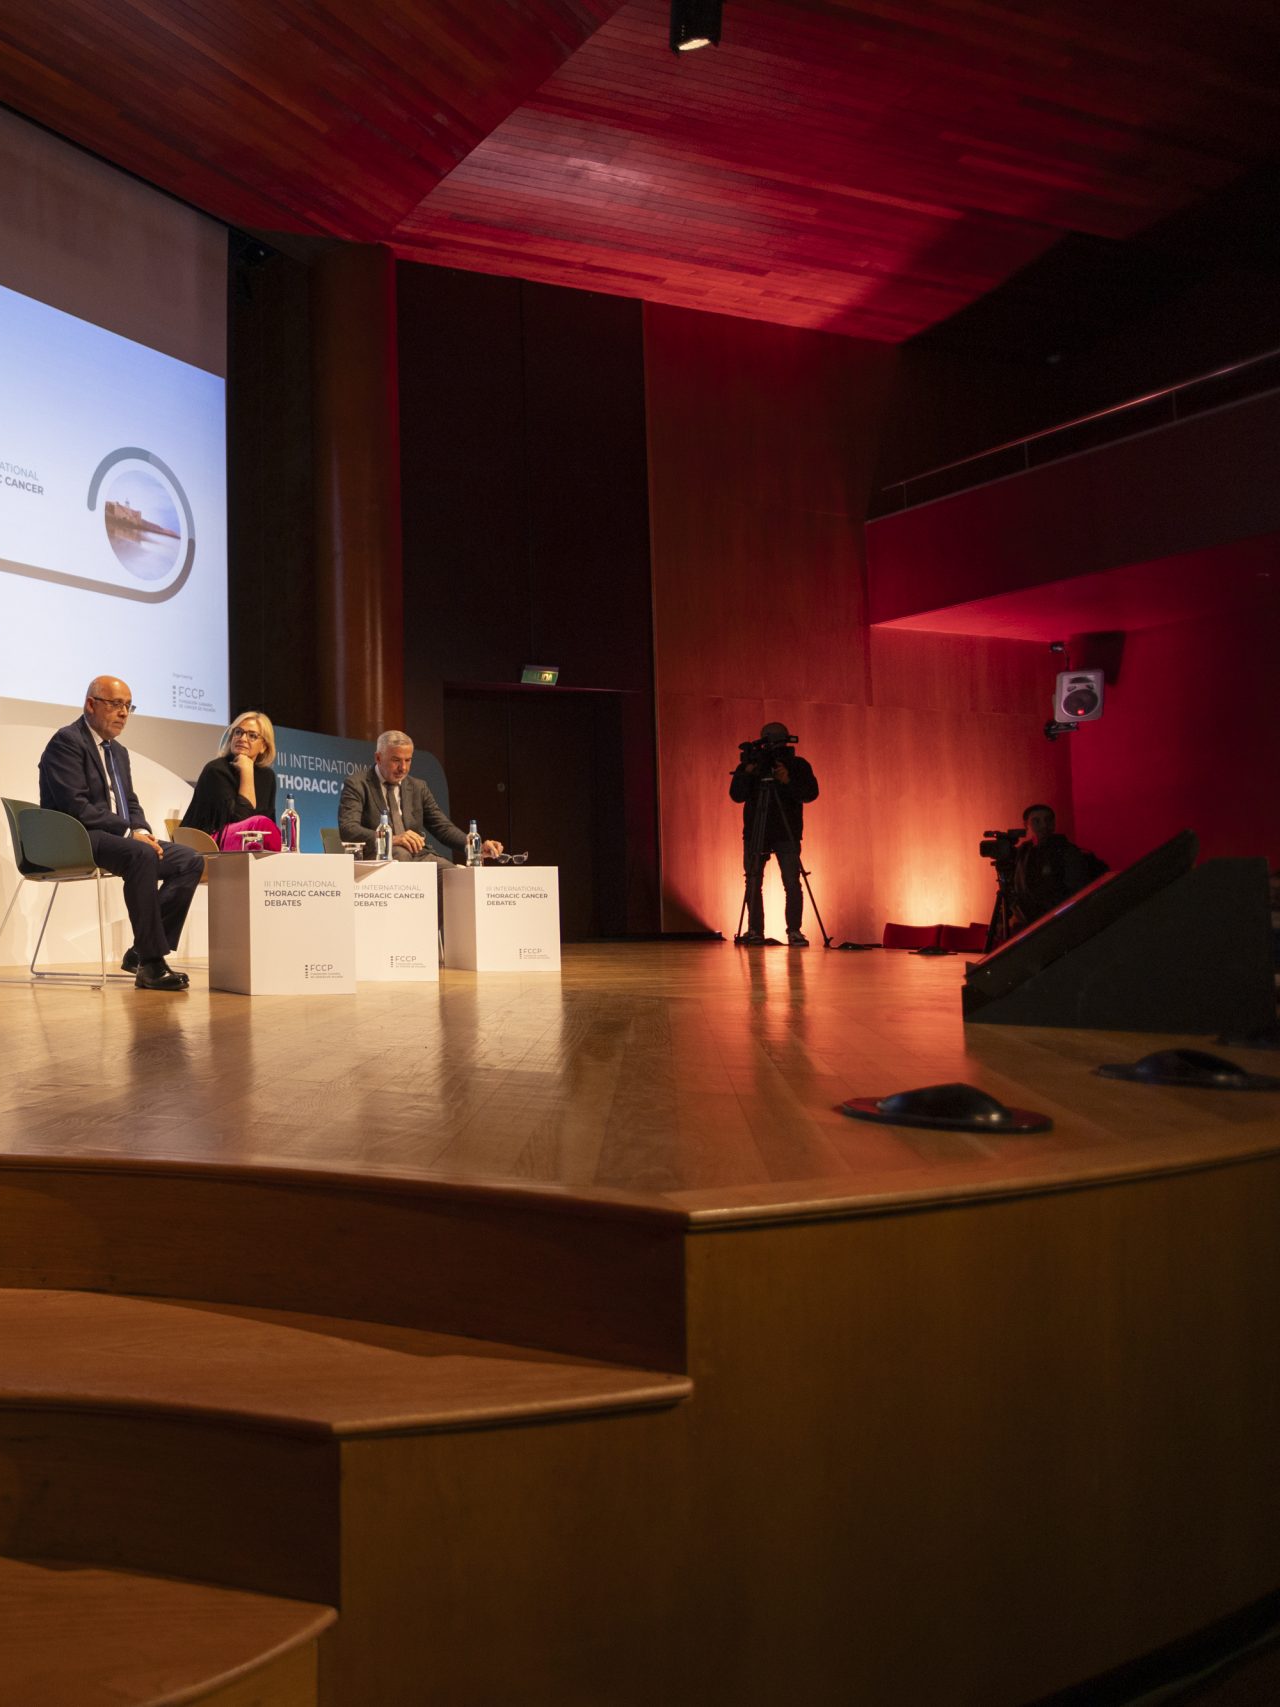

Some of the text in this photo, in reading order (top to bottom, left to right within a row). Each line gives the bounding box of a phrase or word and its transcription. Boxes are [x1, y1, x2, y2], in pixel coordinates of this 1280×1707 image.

[5, 476, 44, 495] CANCER
[178, 686, 205, 699] FCCP
[277, 752, 372, 776] III INTERNATIONA
[277, 774, 338, 794] THORACIC
[274, 880, 336, 888] INTERNATIONAL
[310, 964, 334, 972] FCCP
